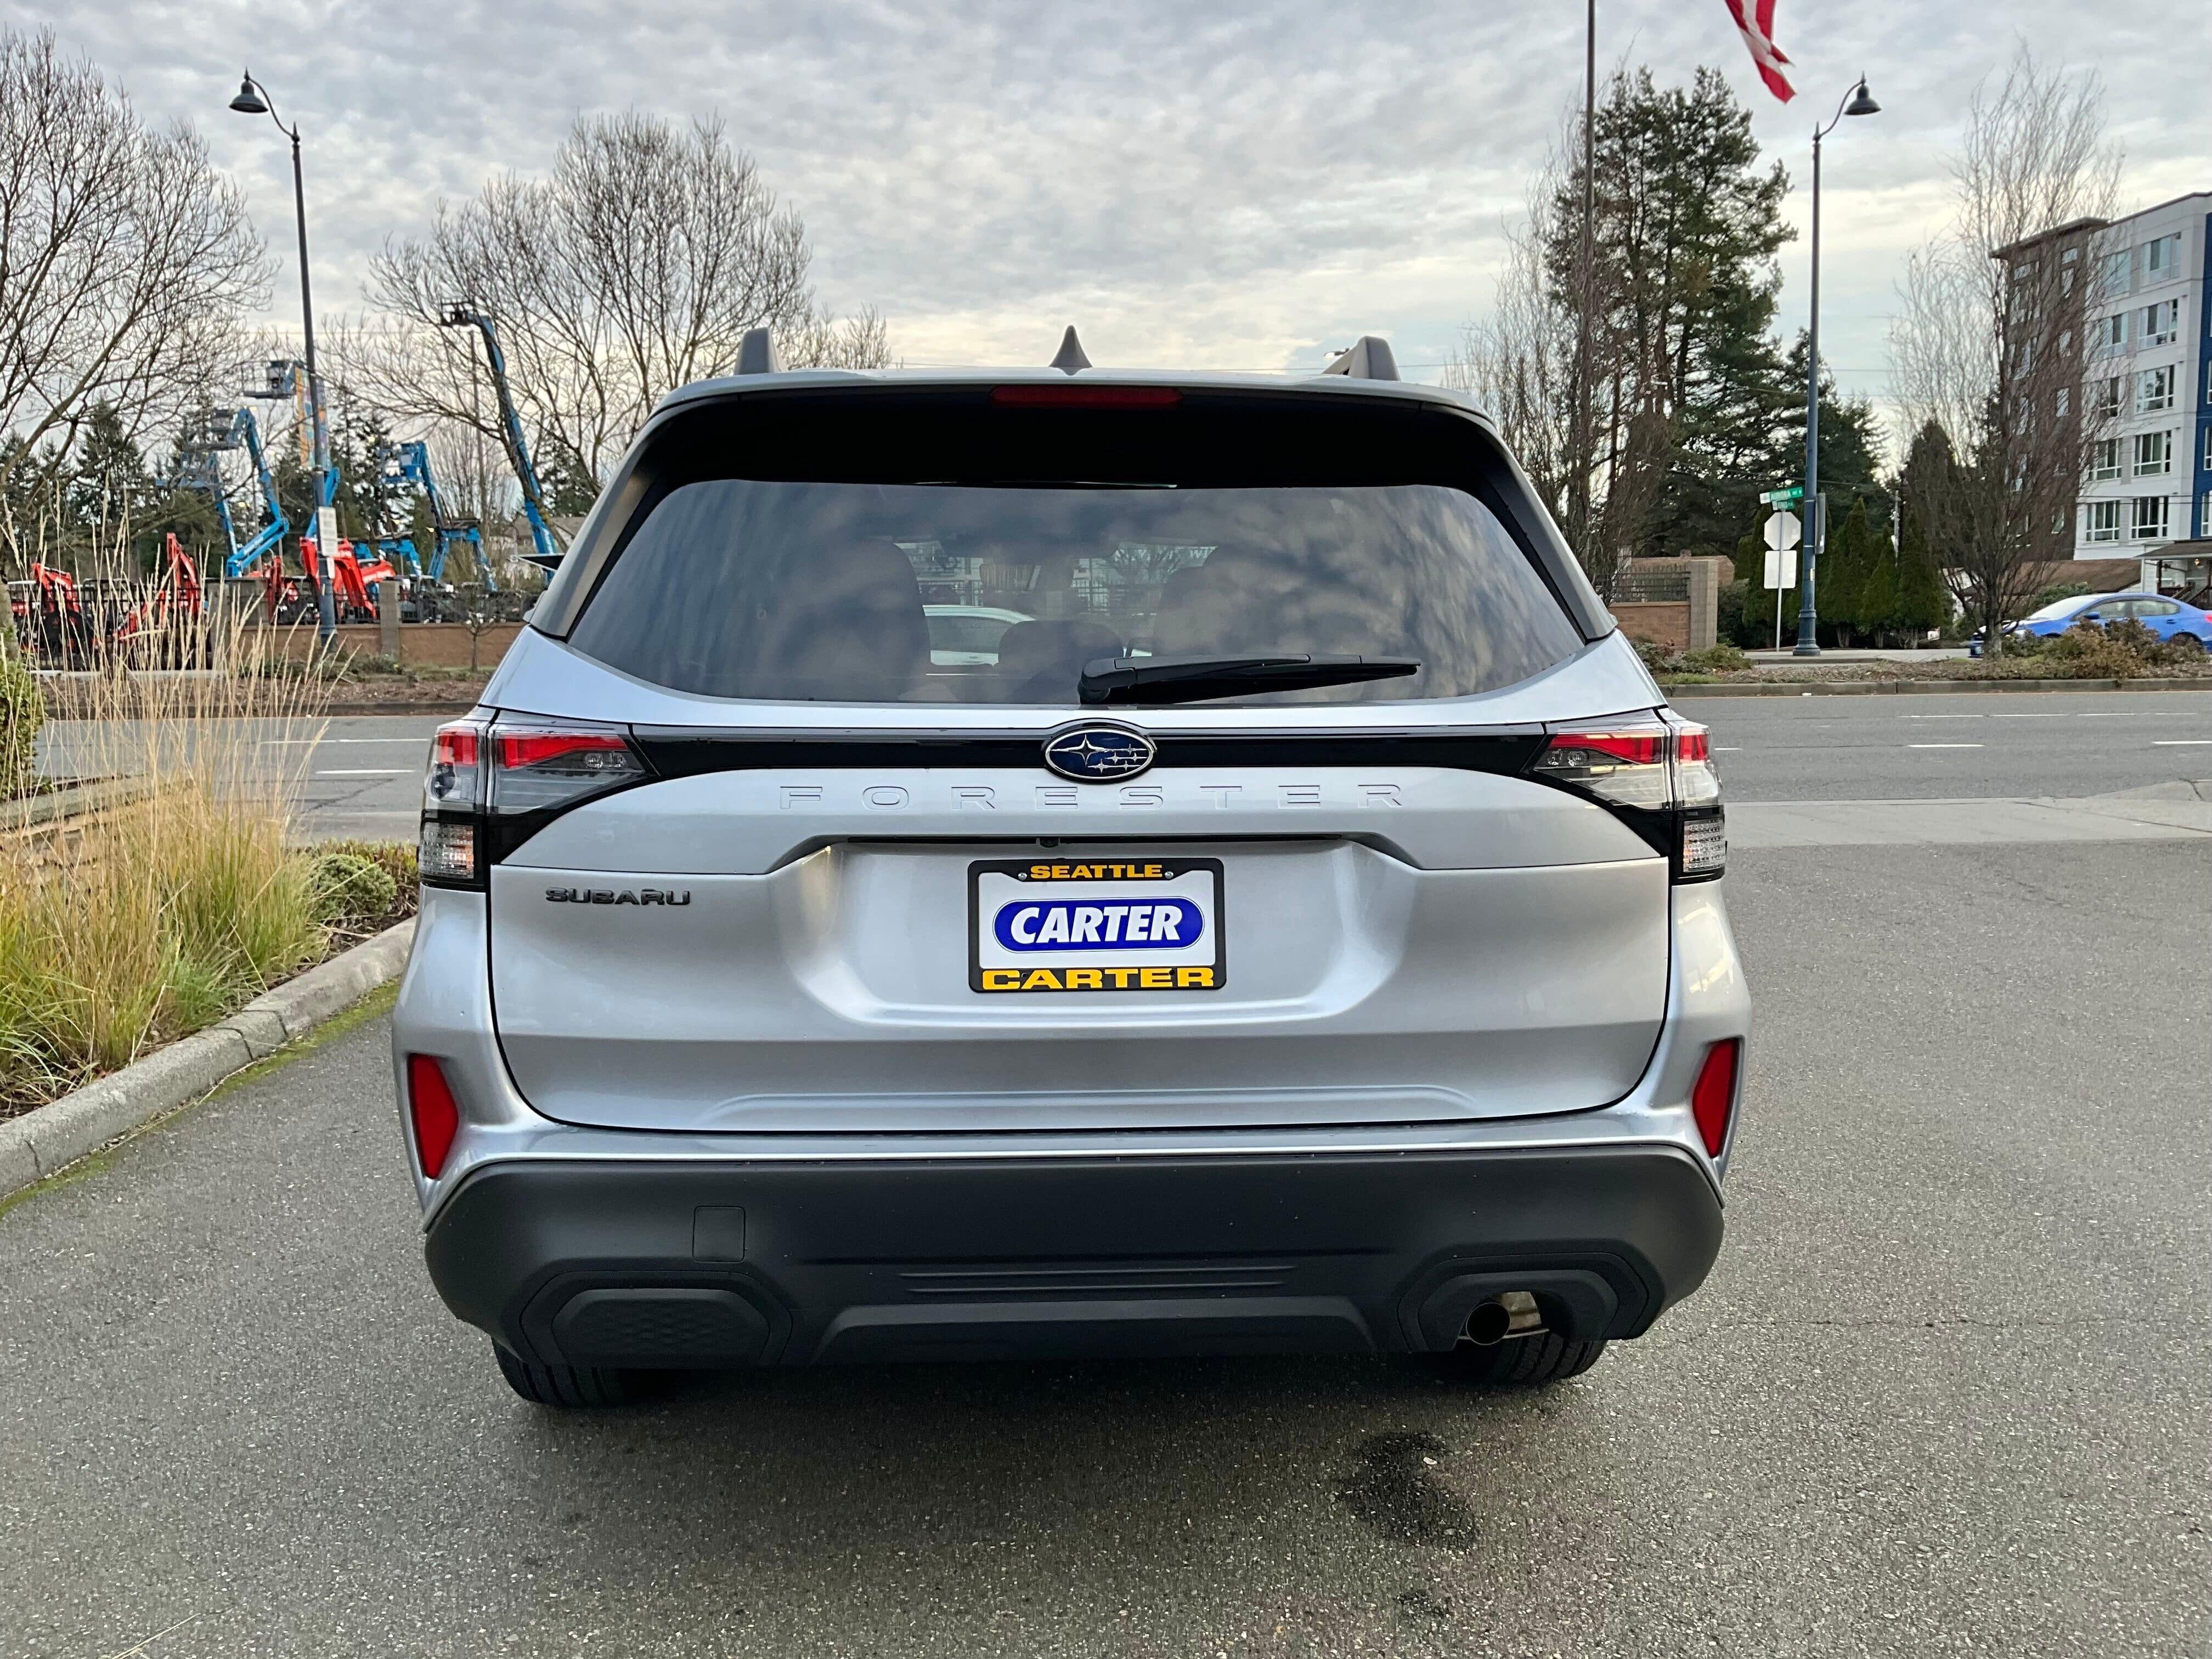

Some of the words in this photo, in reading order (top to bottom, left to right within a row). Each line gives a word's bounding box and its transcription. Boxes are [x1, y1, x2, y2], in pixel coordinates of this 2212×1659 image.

[780, 785, 1402, 810] FORESTER
[1030, 865, 1163, 879] SEATTLE
[546, 887, 690, 905] SUBARU
[1011, 905, 1182, 944] CARTER
[982, 967, 1214, 990] CARTER
